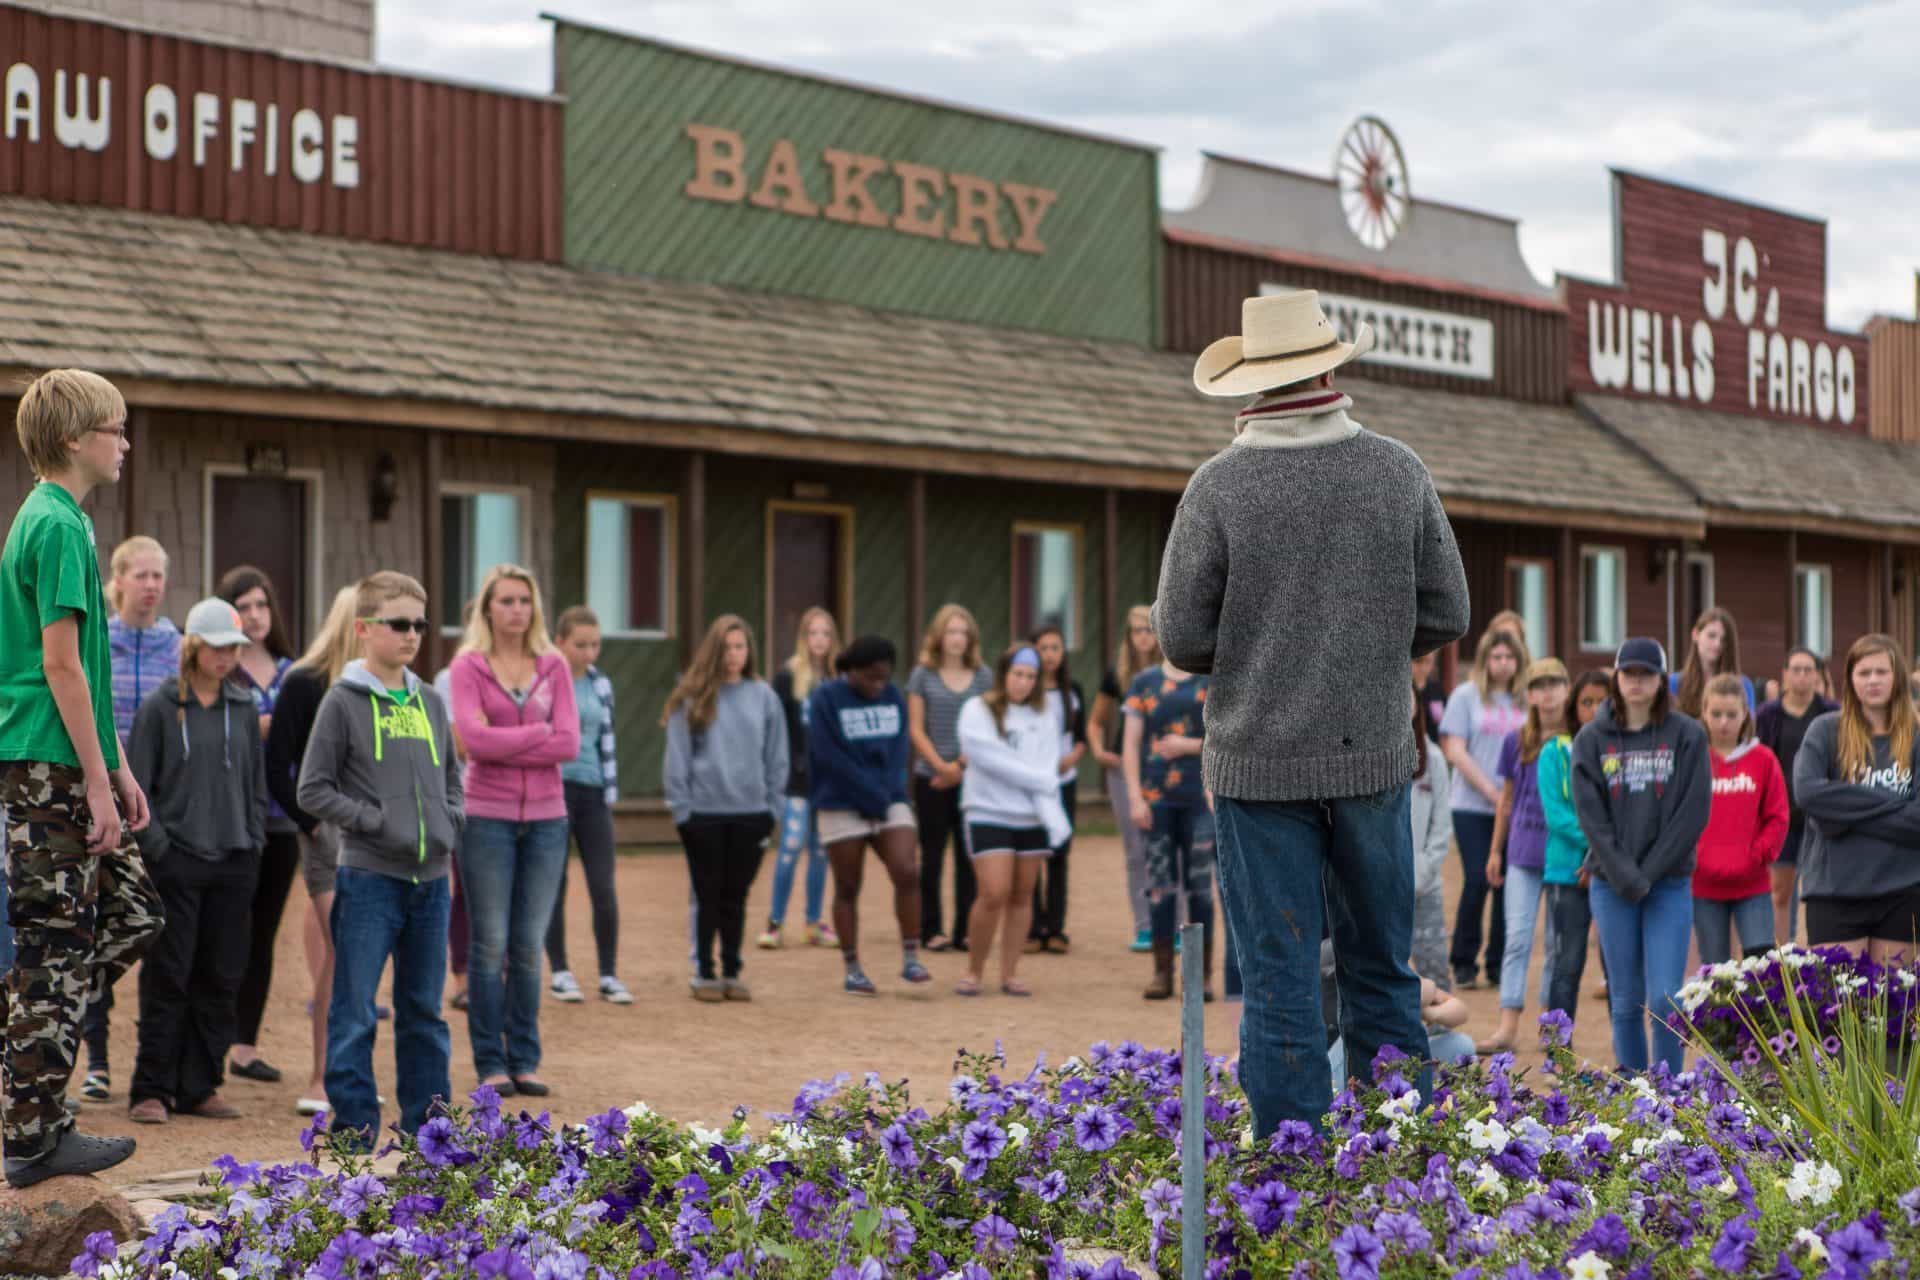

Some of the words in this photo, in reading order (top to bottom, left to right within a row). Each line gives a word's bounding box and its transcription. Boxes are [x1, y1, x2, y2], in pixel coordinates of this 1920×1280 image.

[144, 84, 360, 188] OFFICE
[685, 123, 1057, 255] BAKERY
[1323, 303, 1471, 365] NSMITH
[1588, 299, 1715, 403] WELLS
[1748, 328, 1856, 424] FARGO
